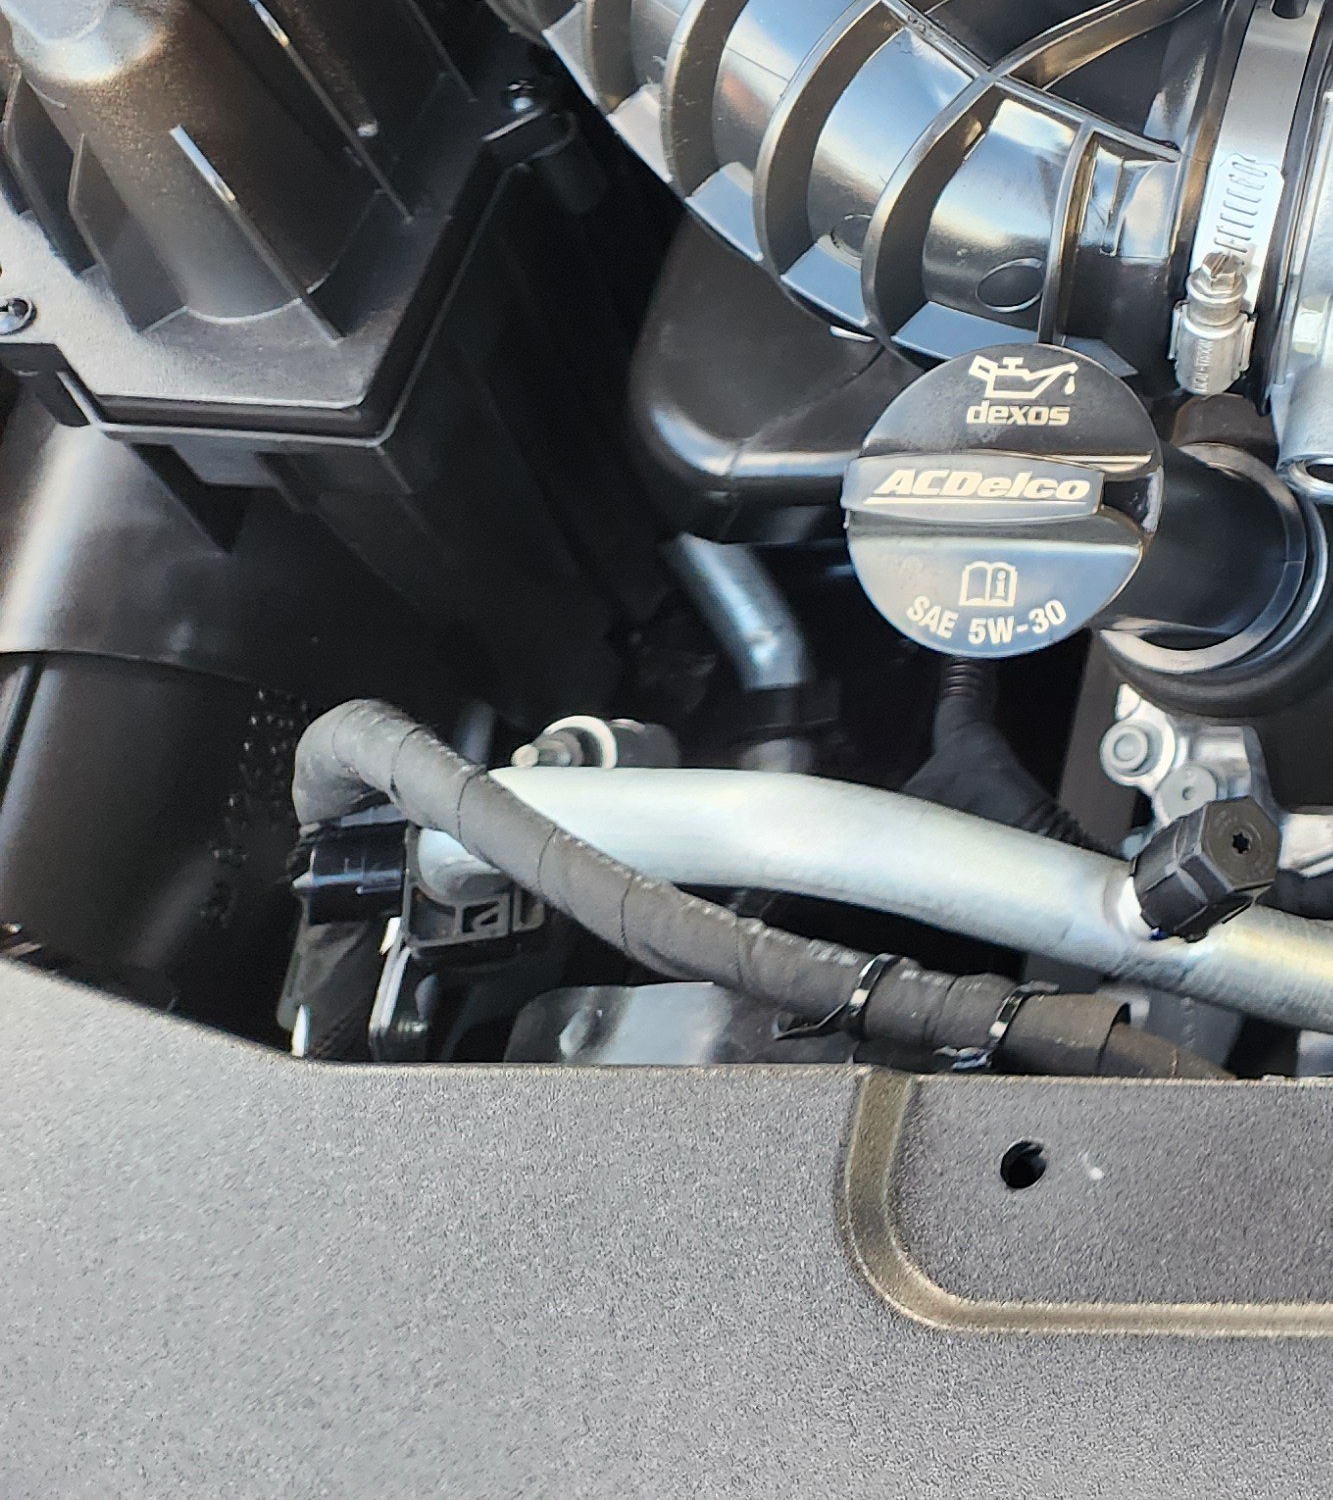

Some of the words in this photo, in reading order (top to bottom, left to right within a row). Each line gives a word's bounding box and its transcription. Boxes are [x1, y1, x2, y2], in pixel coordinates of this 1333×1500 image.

[966, 399, 1071, 427] dexos
[874, 468, 1091, 501] ACDelco
[905, 595, 956, 640] SAE
[968, 598, 1068, 645] 5W-30
